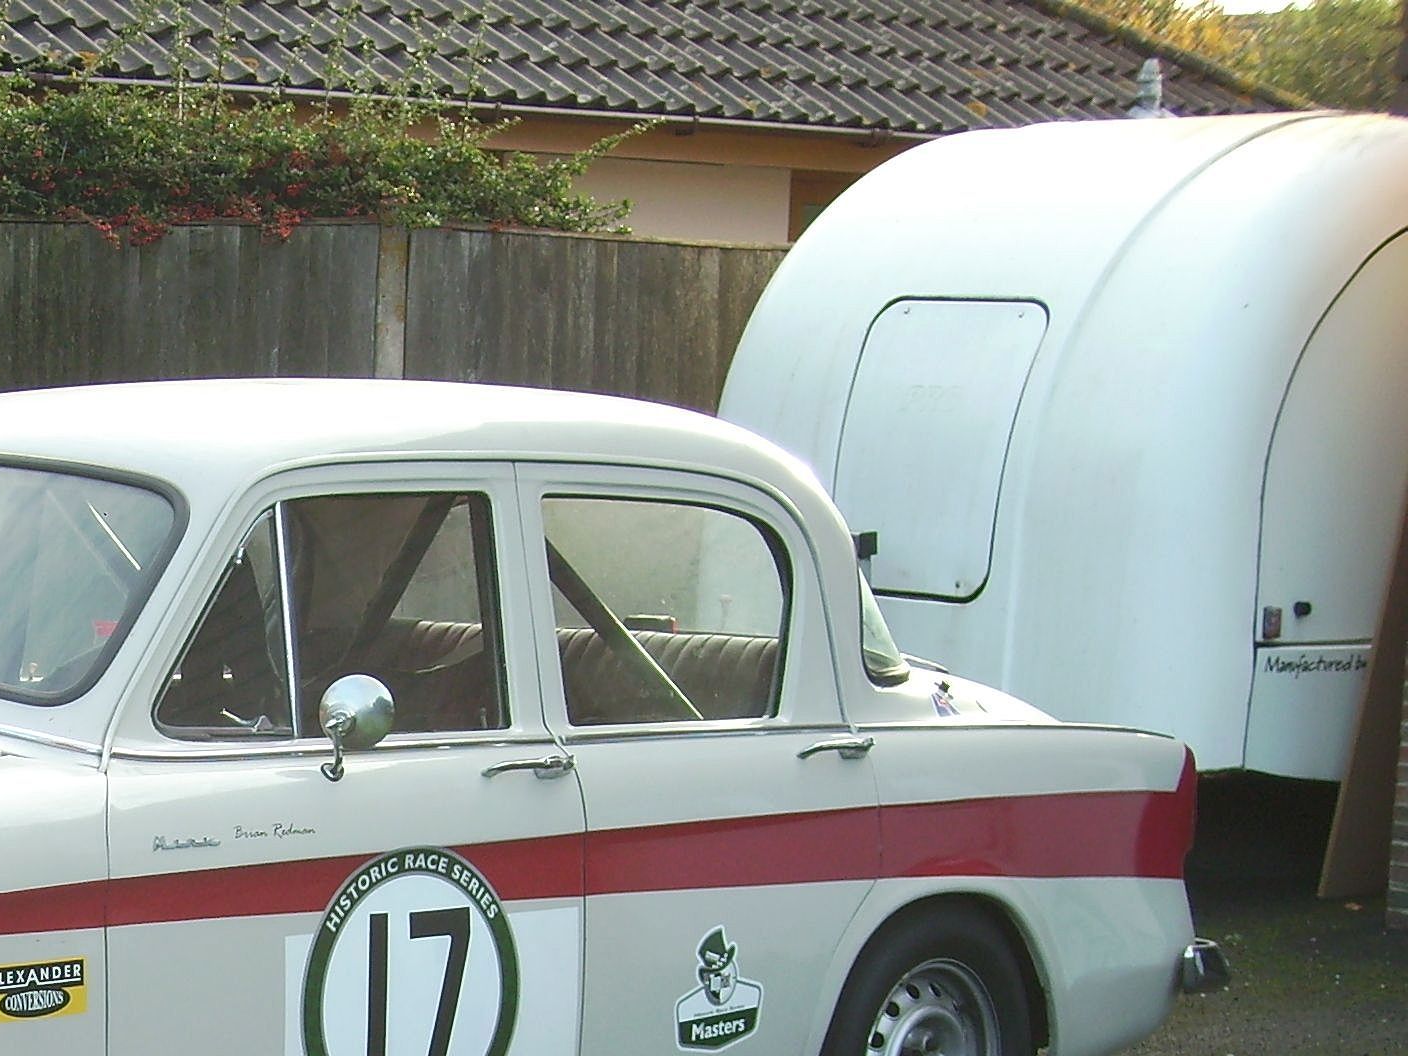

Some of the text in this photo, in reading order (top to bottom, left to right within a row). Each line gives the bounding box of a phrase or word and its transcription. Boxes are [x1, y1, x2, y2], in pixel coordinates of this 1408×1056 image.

[1263, 653, 1354, 679] Manufactured
[325, 853, 499, 932] HISTORIC RACE SERIES
[4, 989, 65, 1012] CONVERSIONS
[691, 1018, 746, 1041] Masters
